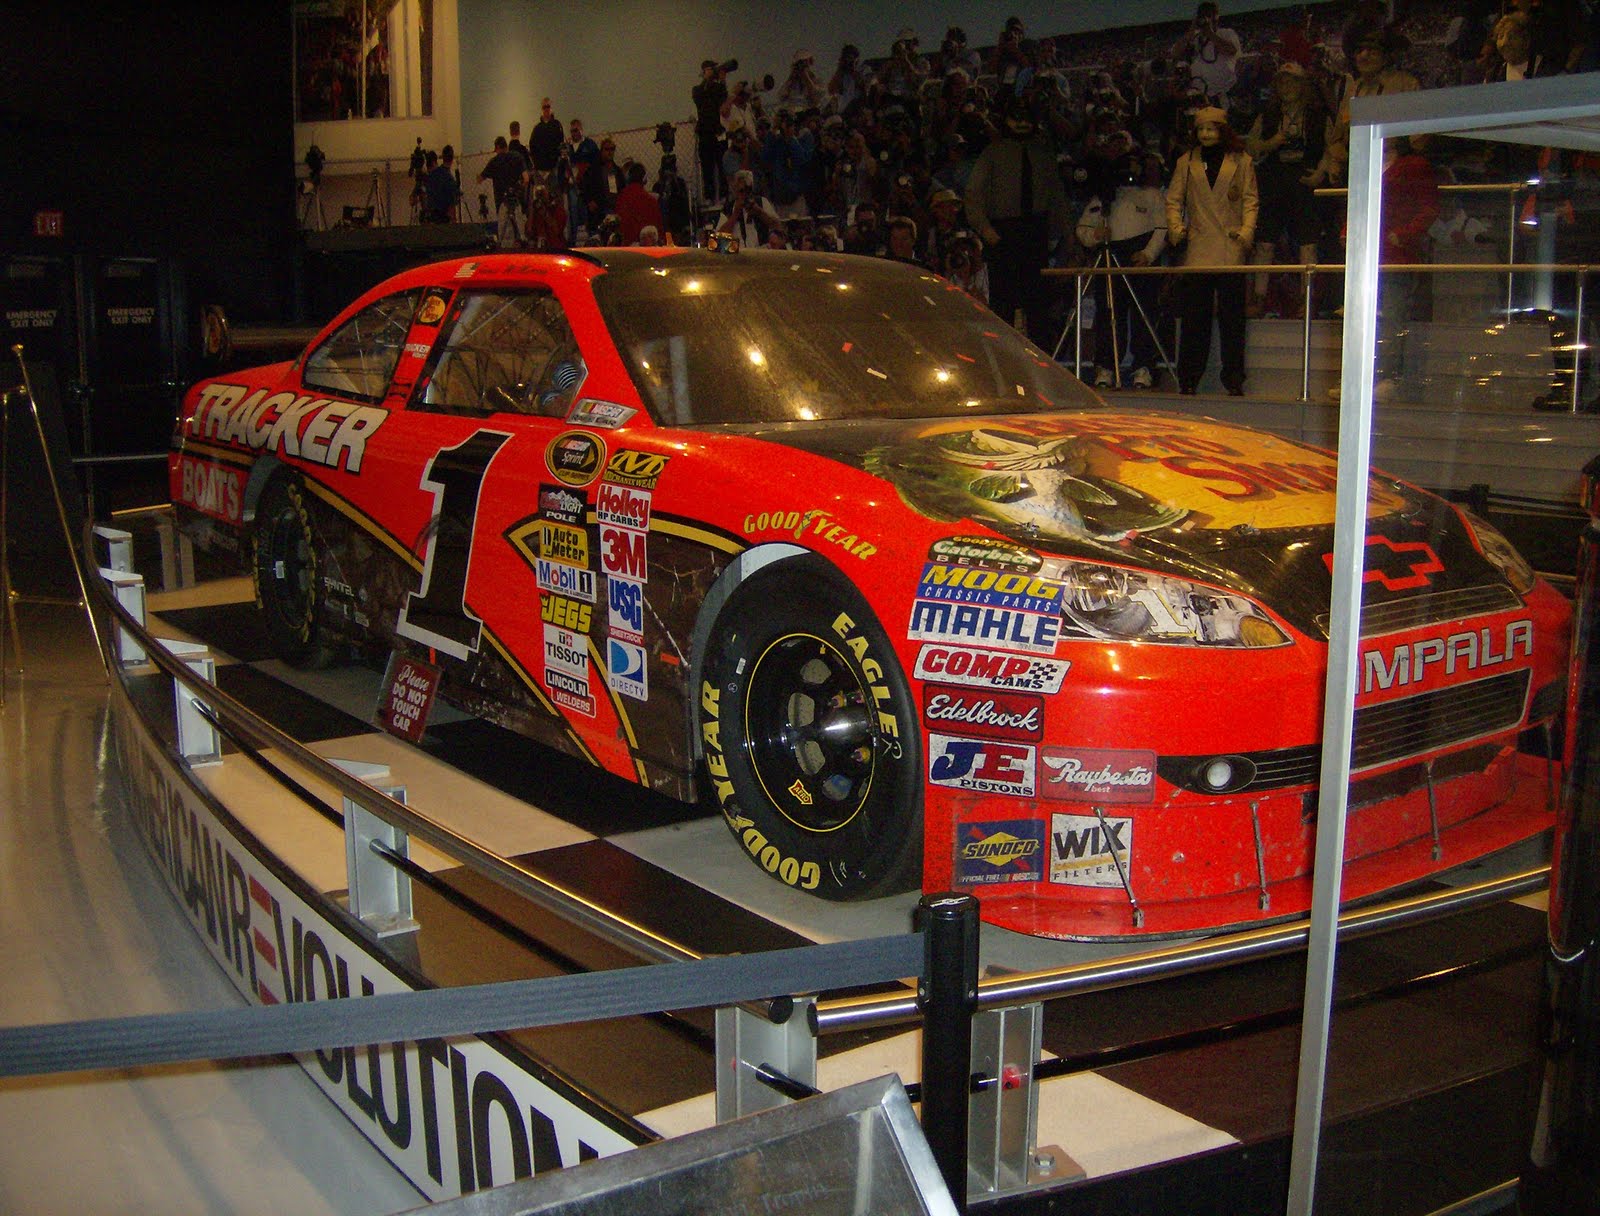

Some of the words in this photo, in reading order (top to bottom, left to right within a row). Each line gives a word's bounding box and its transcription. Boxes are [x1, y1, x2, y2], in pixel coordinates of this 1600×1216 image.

[6, 310, 57, 320] EMERGENCY
[10, 319, 28, 328] EXIT
[107, 308, 154, 317] EMERGENCY
[111, 316, 128, 324] EXIT
[131, 316, 152, 324] ONLY
[190, 383, 390, 474] TRACKER
[562, 451, 584, 465] Sprint
[182, 460, 240, 521] BOATS
[635, 478, 657, 489] WEAR
[546, 511, 577, 523] POLE
[560, 500, 583, 514] LIGHT
[599, 485, 649, 528] Holley
[598, 511, 608, 520] HP
[610, 514, 639, 527] CARBS
[397, 428, 515, 661] 1
[553, 528, 578, 546] Auto
[952, 536, 1029, 552] GOODYEAR
[552, 542, 585, 561] Meter
[603, 529, 645, 579] 3M
[932, 540, 1037, 565] Gatorback
[539, 560, 576, 590] Mobil
[936, 554, 1029, 573] BELTS
[922, 565, 1067, 600] MOOG
[610, 578, 642, 632] USG
[925, 586, 991, 603] CHASSIS
[541, 594, 592, 633] JEGS
[911, 601, 1060, 647] MAHLE
[545, 642, 587, 668] TISSOT
[922, 649, 1031, 678] COMP
[398, 664, 430, 692] Please
[547, 671, 587, 697] LINCOLN
[831, 611, 898, 743] EAGLE
[990, 675, 1044, 689] CAMS
[392, 682, 405, 698] DO
[407, 688, 427, 707] NOT
[611, 681, 644, 697] DIRECTV
[392, 697, 420, 720] TOUCH
[556, 691, 591, 713] WELDERS
[926, 694, 1039, 731] Edelbrock
[393, 714, 411, 732] CAR
[931, 741, 1029, 784] JE
[1042, 755, 1153, 792] Raybestos
[959, 779, 1033, 796] PISTONS
[964, 840, 1038, 858] SUNOCO
[1054, 822, 1127, 860] WIX
[1054, 862, 1128, 881] FILTERS
